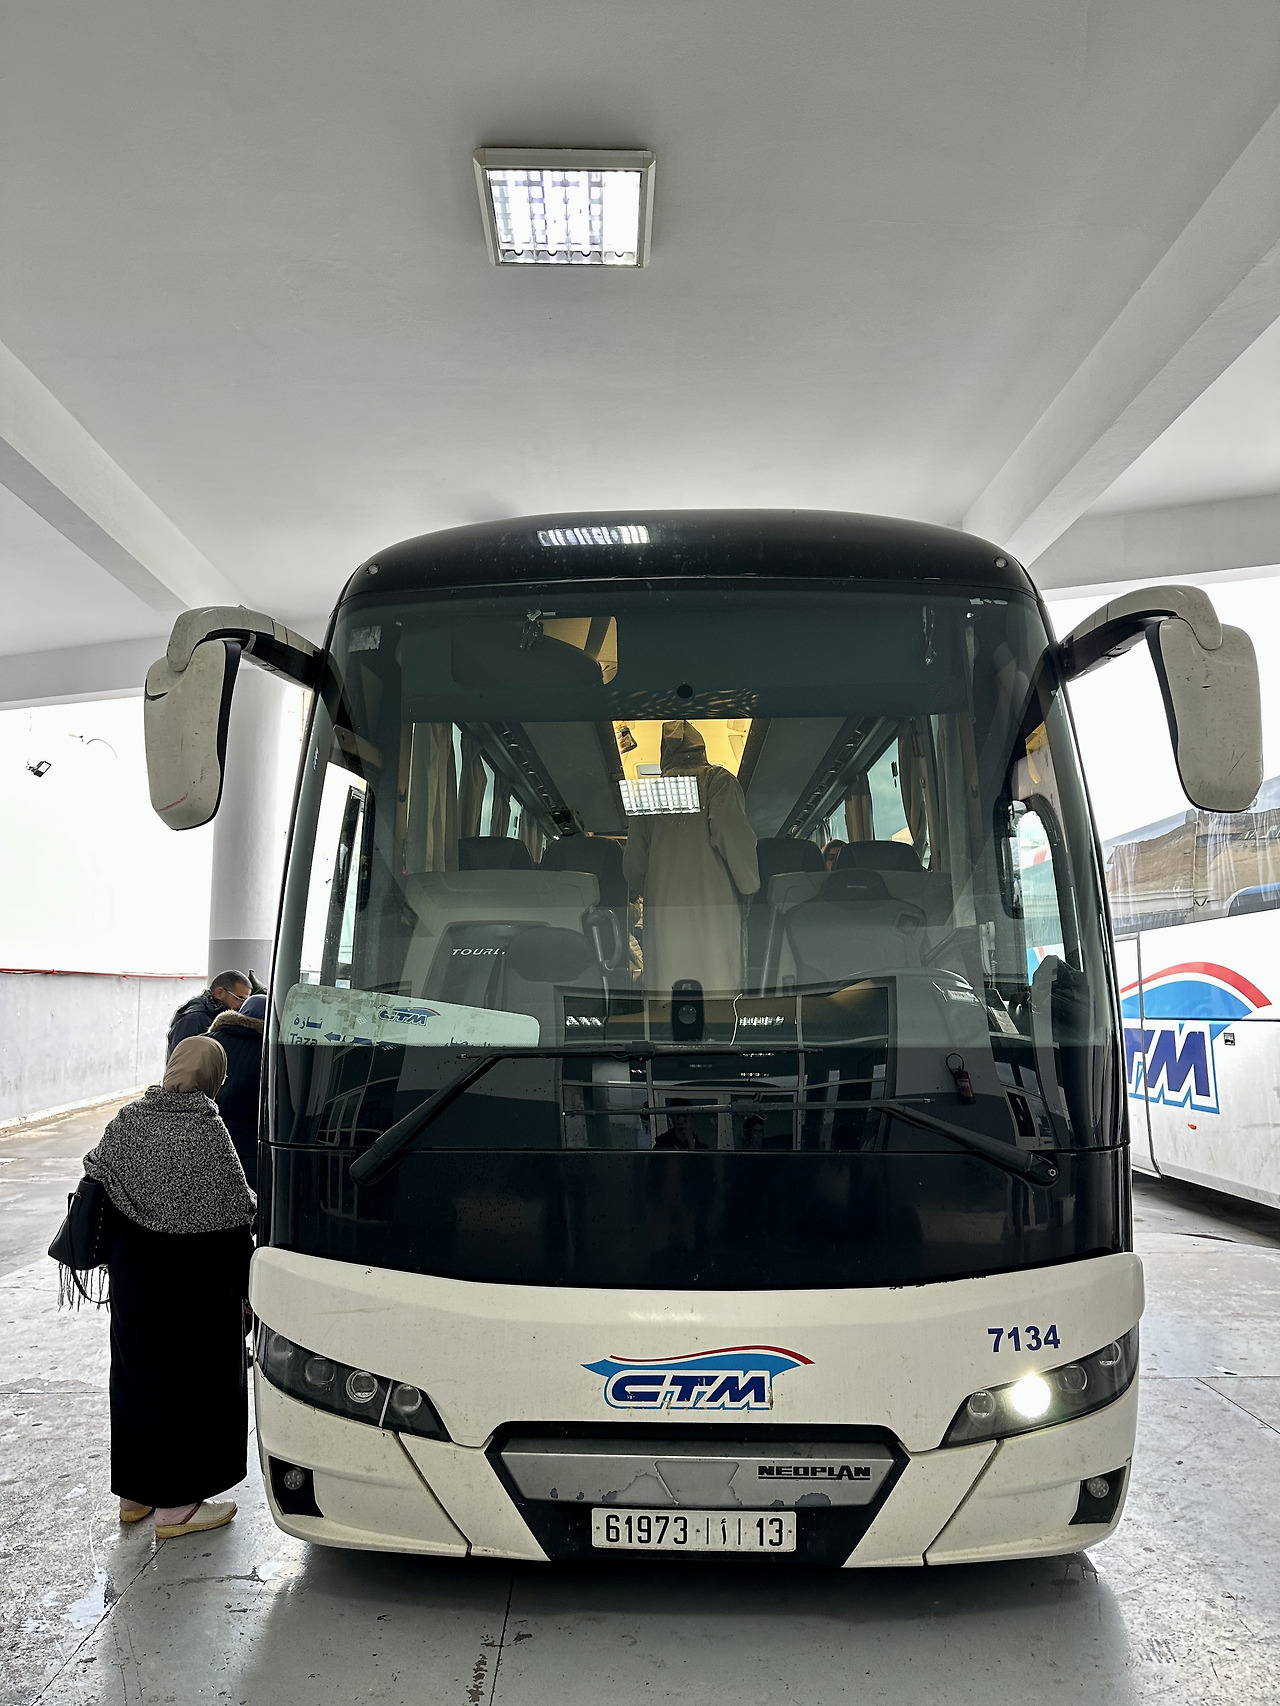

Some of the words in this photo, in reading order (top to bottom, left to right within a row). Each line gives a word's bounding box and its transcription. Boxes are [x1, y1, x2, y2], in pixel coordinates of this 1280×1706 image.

[289, 1032, 319, 1046] Taza
[987, 1324, 1061, 1353] 7134
[609, 1373, 768, 1404] CTM
[757, 1464, 871, 1480] NEOPLAN
[605, 1514, 688, 1545] 61973
[755, 1517, 784, 1547] 13
